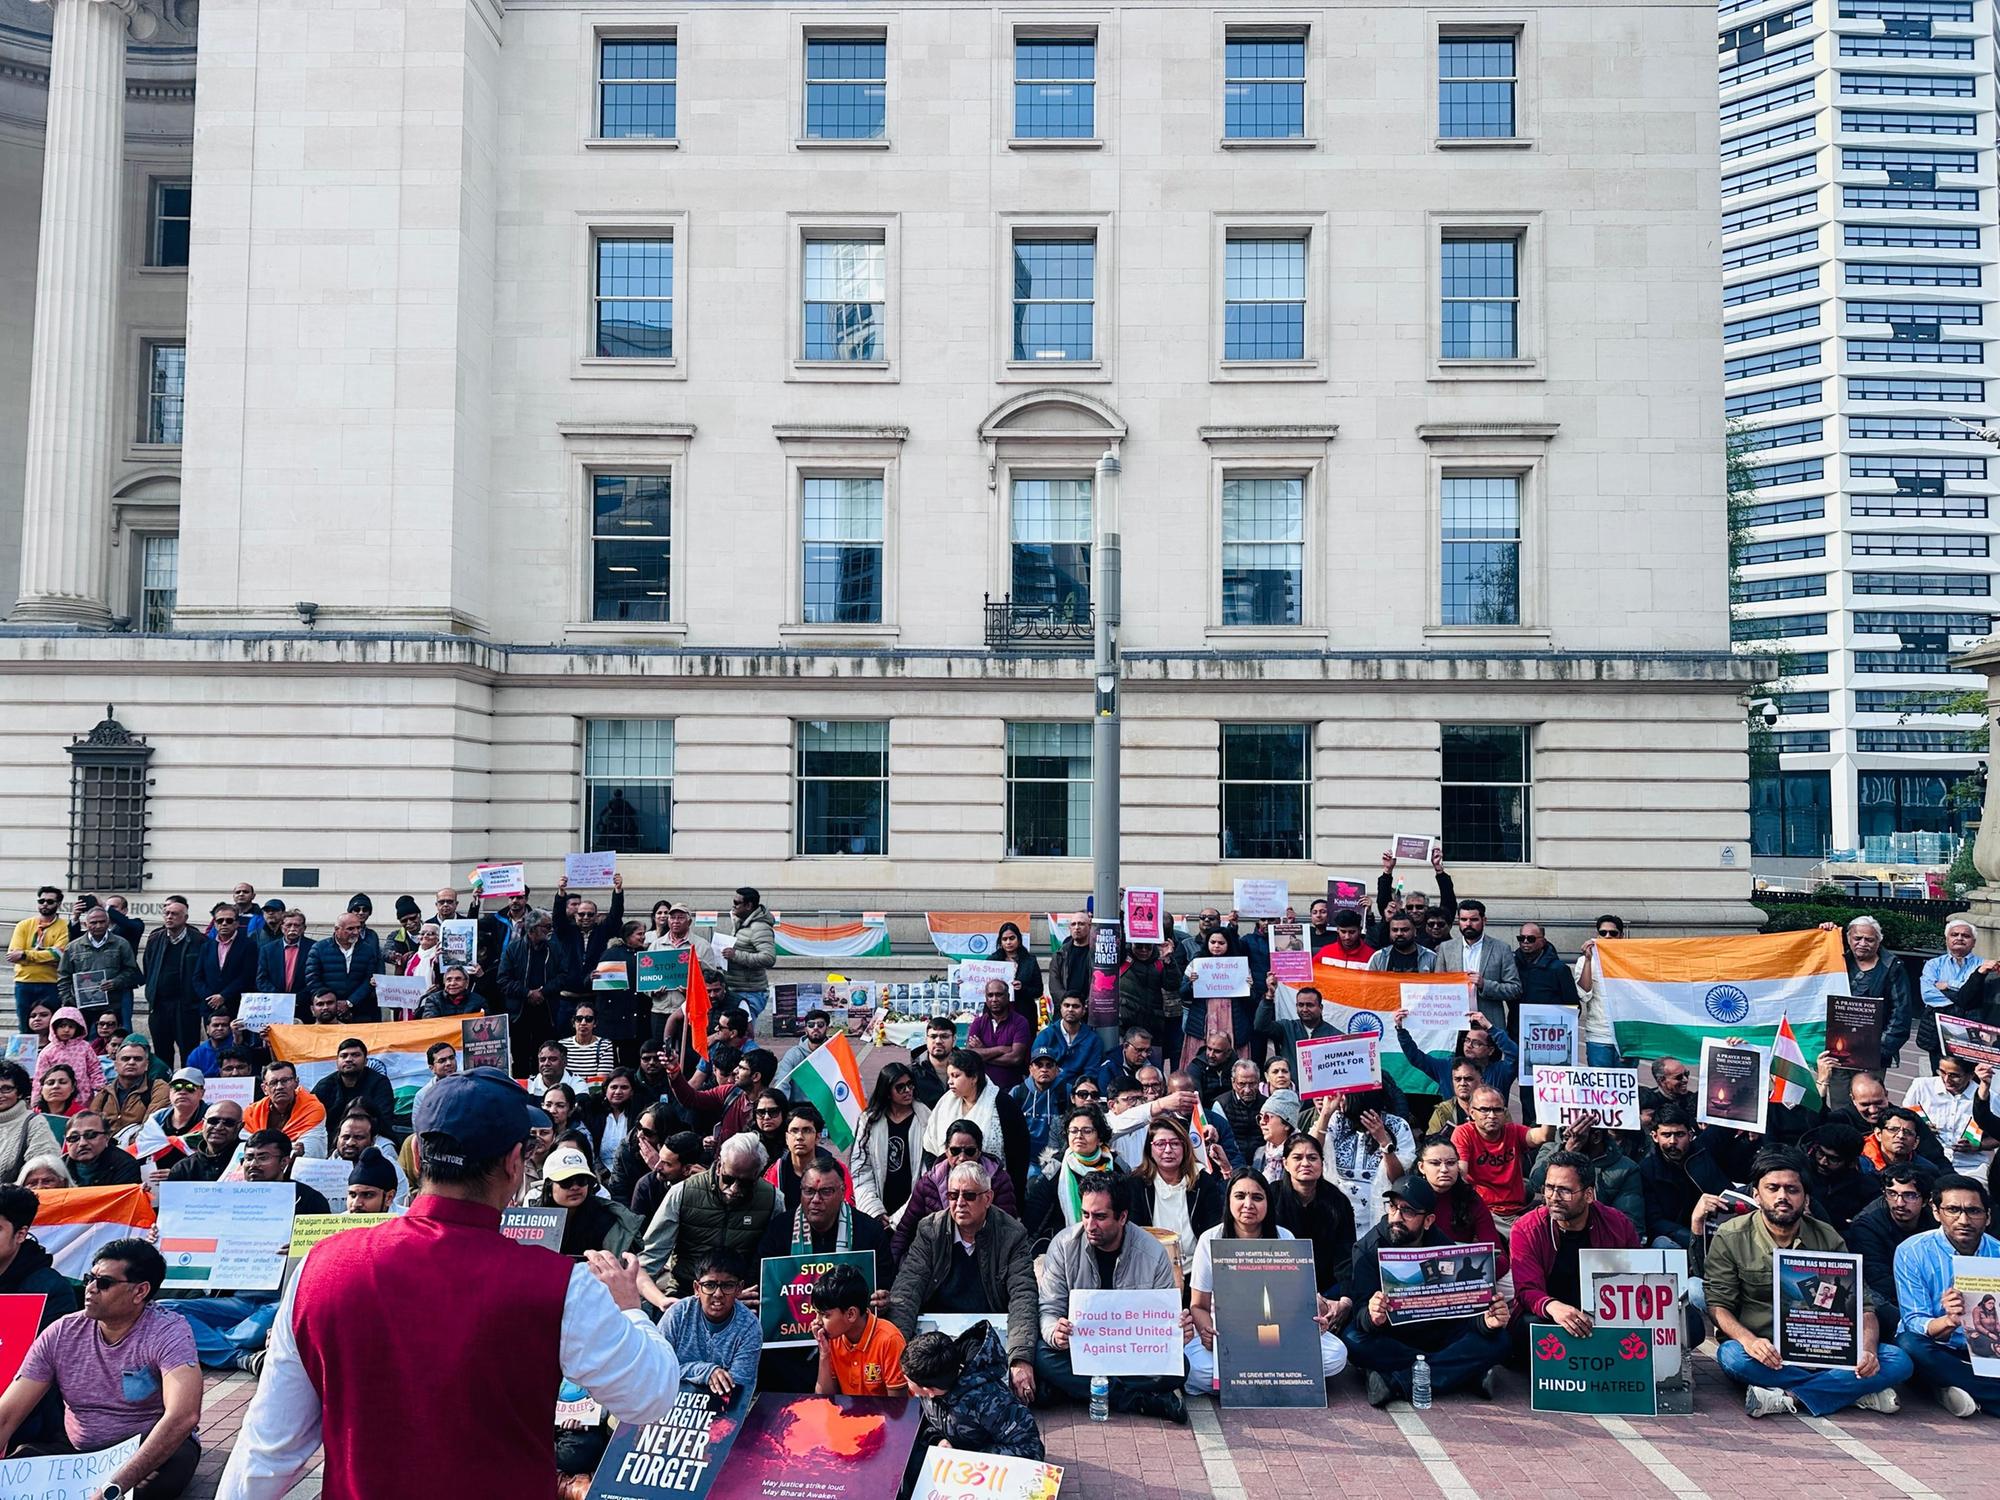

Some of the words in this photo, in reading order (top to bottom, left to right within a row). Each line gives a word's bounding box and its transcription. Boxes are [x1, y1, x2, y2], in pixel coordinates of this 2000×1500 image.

[1095, 943, 1117, 953] NEVER
[1094, 953, 1118, 964] FORGET
[654, 962, 676, 971] STOP
[640, 974, 663, 982] HINDU
[1532, 1027, 1565, 1041] STOP
[1530, 1043, 1566, 1051] TERRORISM
[1324, 1050, 1354, 1060] HUMAN
[1347, 1057, 1364, 1065] FOR
[1536, 1069, 1565, 1085] STOP
[1565, 1071, 1636, 1089] TARGETTED
[1618, 1090, 1637, 1106] OF
[295, 1217, 321, 1226] Pahalgam
[341, 1216, 362, 1224] Witness
[363, 1217, 376, 1225] says
[507, 1214, 557, 1227] RELIGION
[503, 1227, 544, 1240] BUSTED
[1783, 1258, 1805, 1267] TERROR
[1599, 1284, 1673, 1321] STOP
[1075, 1310, 1108, 1321] Proud
[1111, 1311, 1122, 1320] to
[1125, 1310, 1139, 1320] Be
[1142, 1310, 1175, 1320] Hindu
[1077, 1327, 1096, 1337] We
[1098, 1327, 1132, 1337] Stand
[1135, 1326, 1173, 1336] United
[1083, 1343, 1127, 1356] Against
[1130, 1342, 1168, 1353] Terror!
[1568, 1356, 1615, 1371] STOP
[1539, 1378, 1586, 1392] HINDU
[1590, 1380, 1645, 1393] HATRED
[568, 1400, 594, 1413] SLEEPS
[659, 1410, 717, 1431] ORGIVE
[635, 1424, 711, 1459] NEVER
[1, 1461, 32, 1488] NO
[616, 1452, 708, 1492] FORGET
[762, 1479, 779, 1488] May
[778, 1480, 804, 1488] justice
[805, 1482, 826, 1490] strike
[827, 1483, 846, 1491] loud.
[762, 1488, 779, 1497] May
[780, 1489, 805, 1498] Bharat
[806, 1491, 838, 1500] Awaken.
